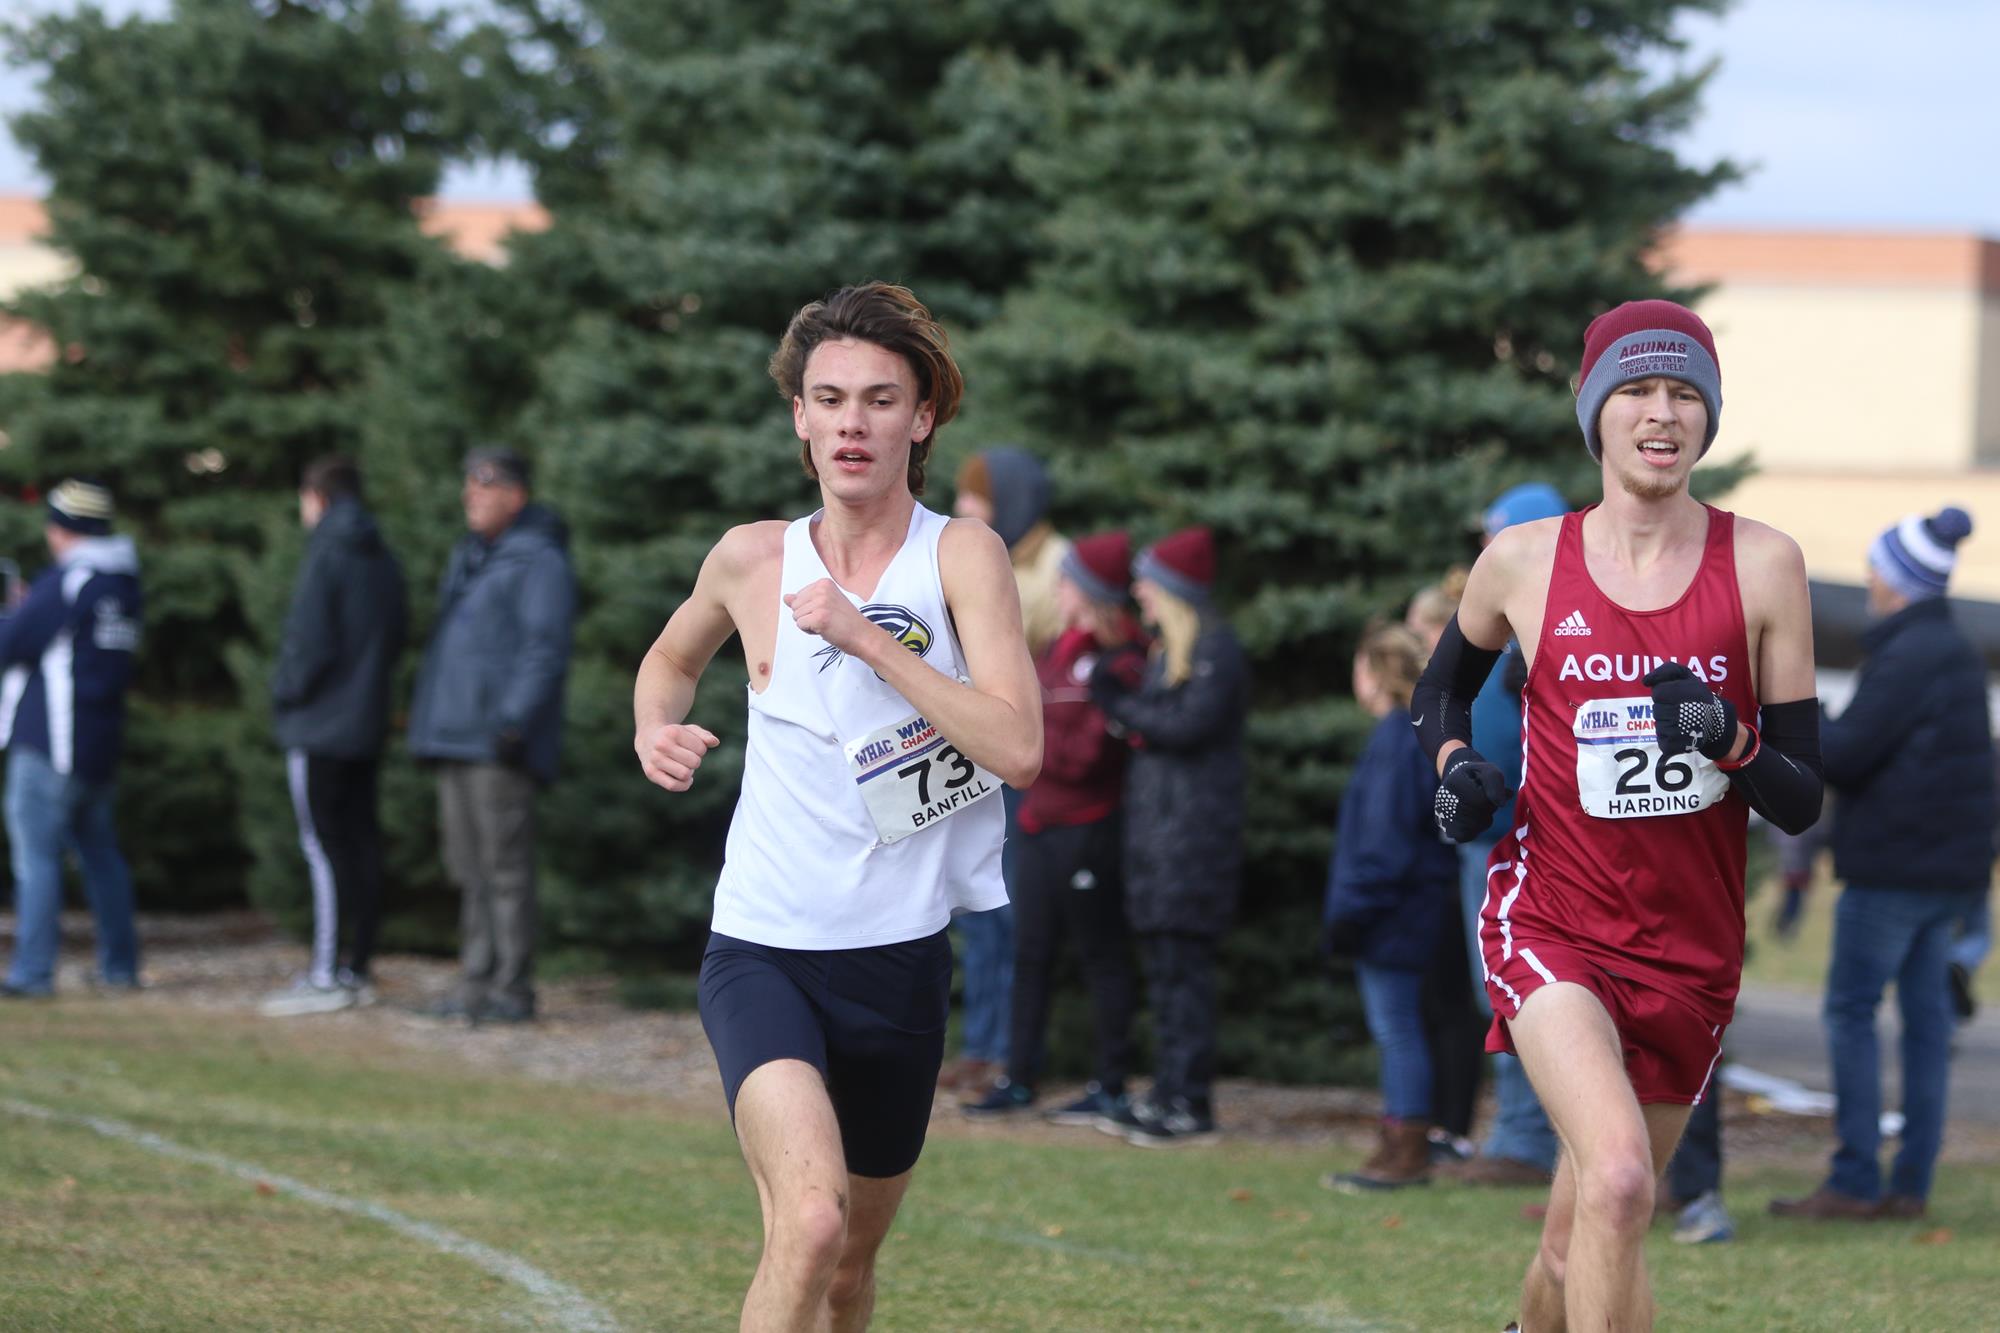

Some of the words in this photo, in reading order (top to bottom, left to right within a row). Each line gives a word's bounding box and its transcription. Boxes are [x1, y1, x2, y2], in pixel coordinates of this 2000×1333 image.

[1619, 341, 1688, 360] AQUINAS
[1619, 357, 1647, 371] CROSS
[1649, 355, 1688, 365] COUNTRY
[1623, 365, 1650, 377] TRACK
[1662, 363, 1685, 373] FIELD
[1554, 626, 1592, 636] adidas
[1581, 711, 1619, 731] WHAC
[854, 739, 894, 767] WHAC
[897, 744, 976, 806] 73
[1613, 748, 1693, 796] 26
[912, 780, 990, 828] BANFILL
[1608, 794, 1700, 815] HARDING
